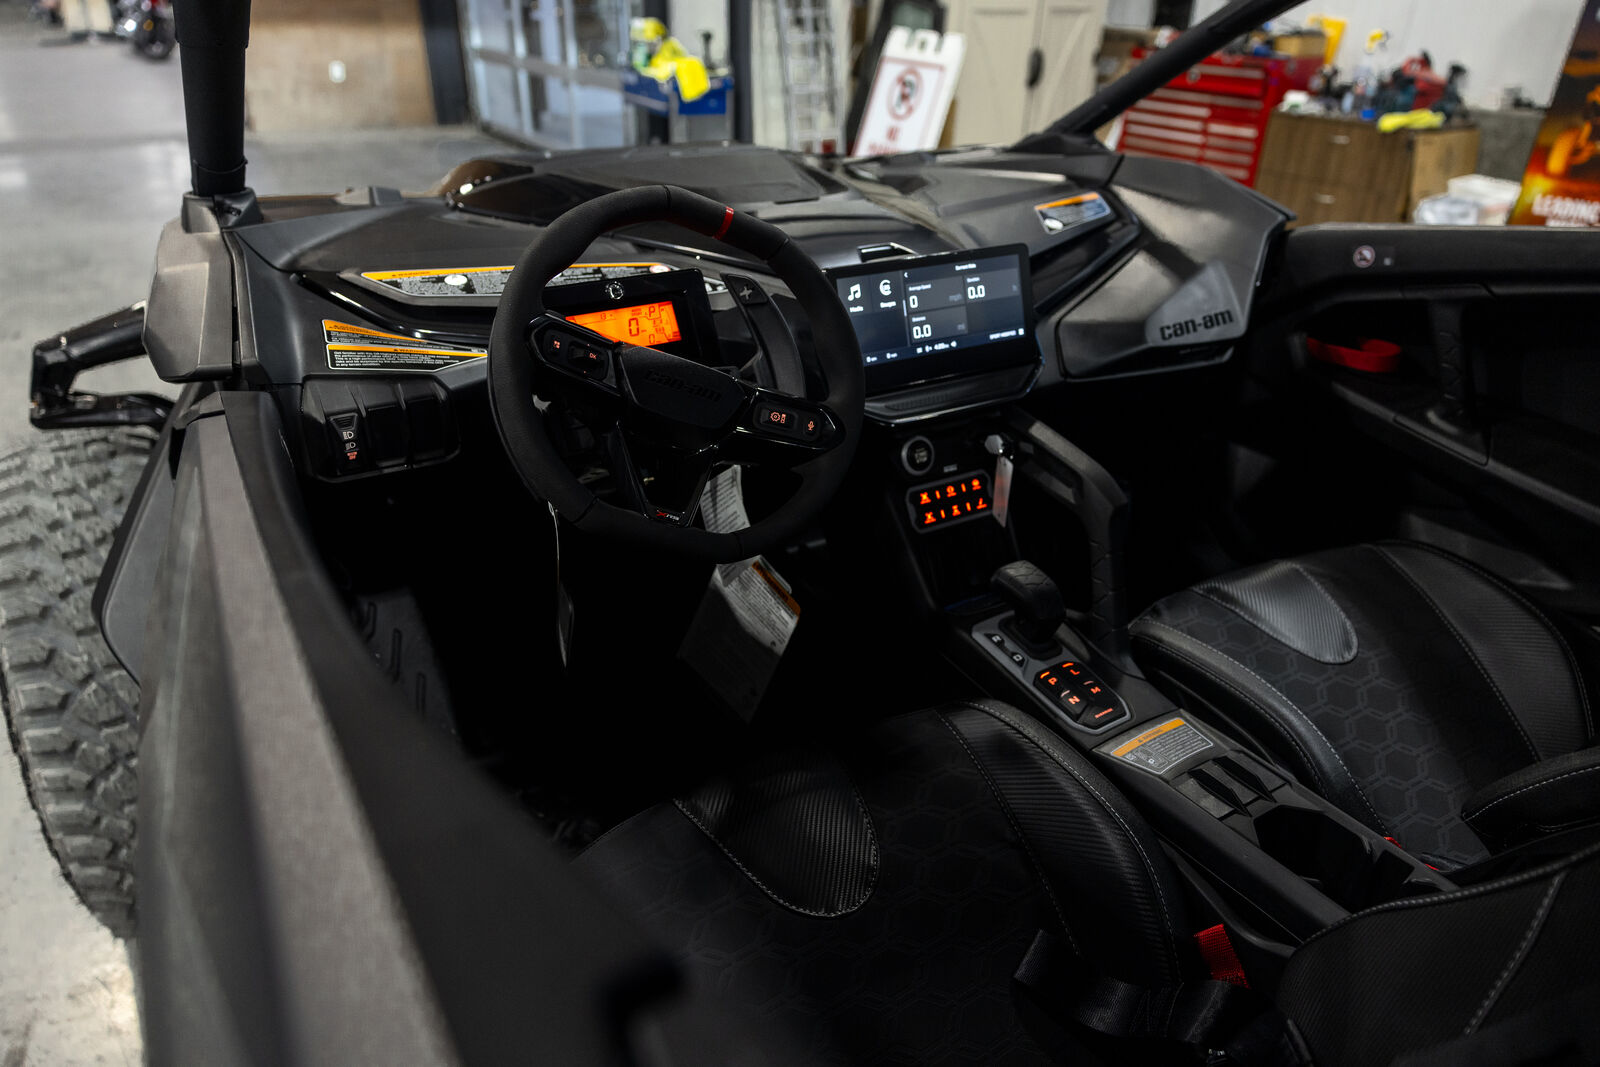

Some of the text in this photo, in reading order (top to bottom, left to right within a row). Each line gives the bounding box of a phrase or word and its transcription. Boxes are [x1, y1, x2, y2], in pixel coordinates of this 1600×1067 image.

[968, 285, 985, 299] 0.0
[910, 295, 918, 308] 0
[628, 317, 640, 336] 0
[913, 324, 931, 339] 0.0
[1160, 309, 1234, 341] can-am
[1048, 677, 1057, 686] P
